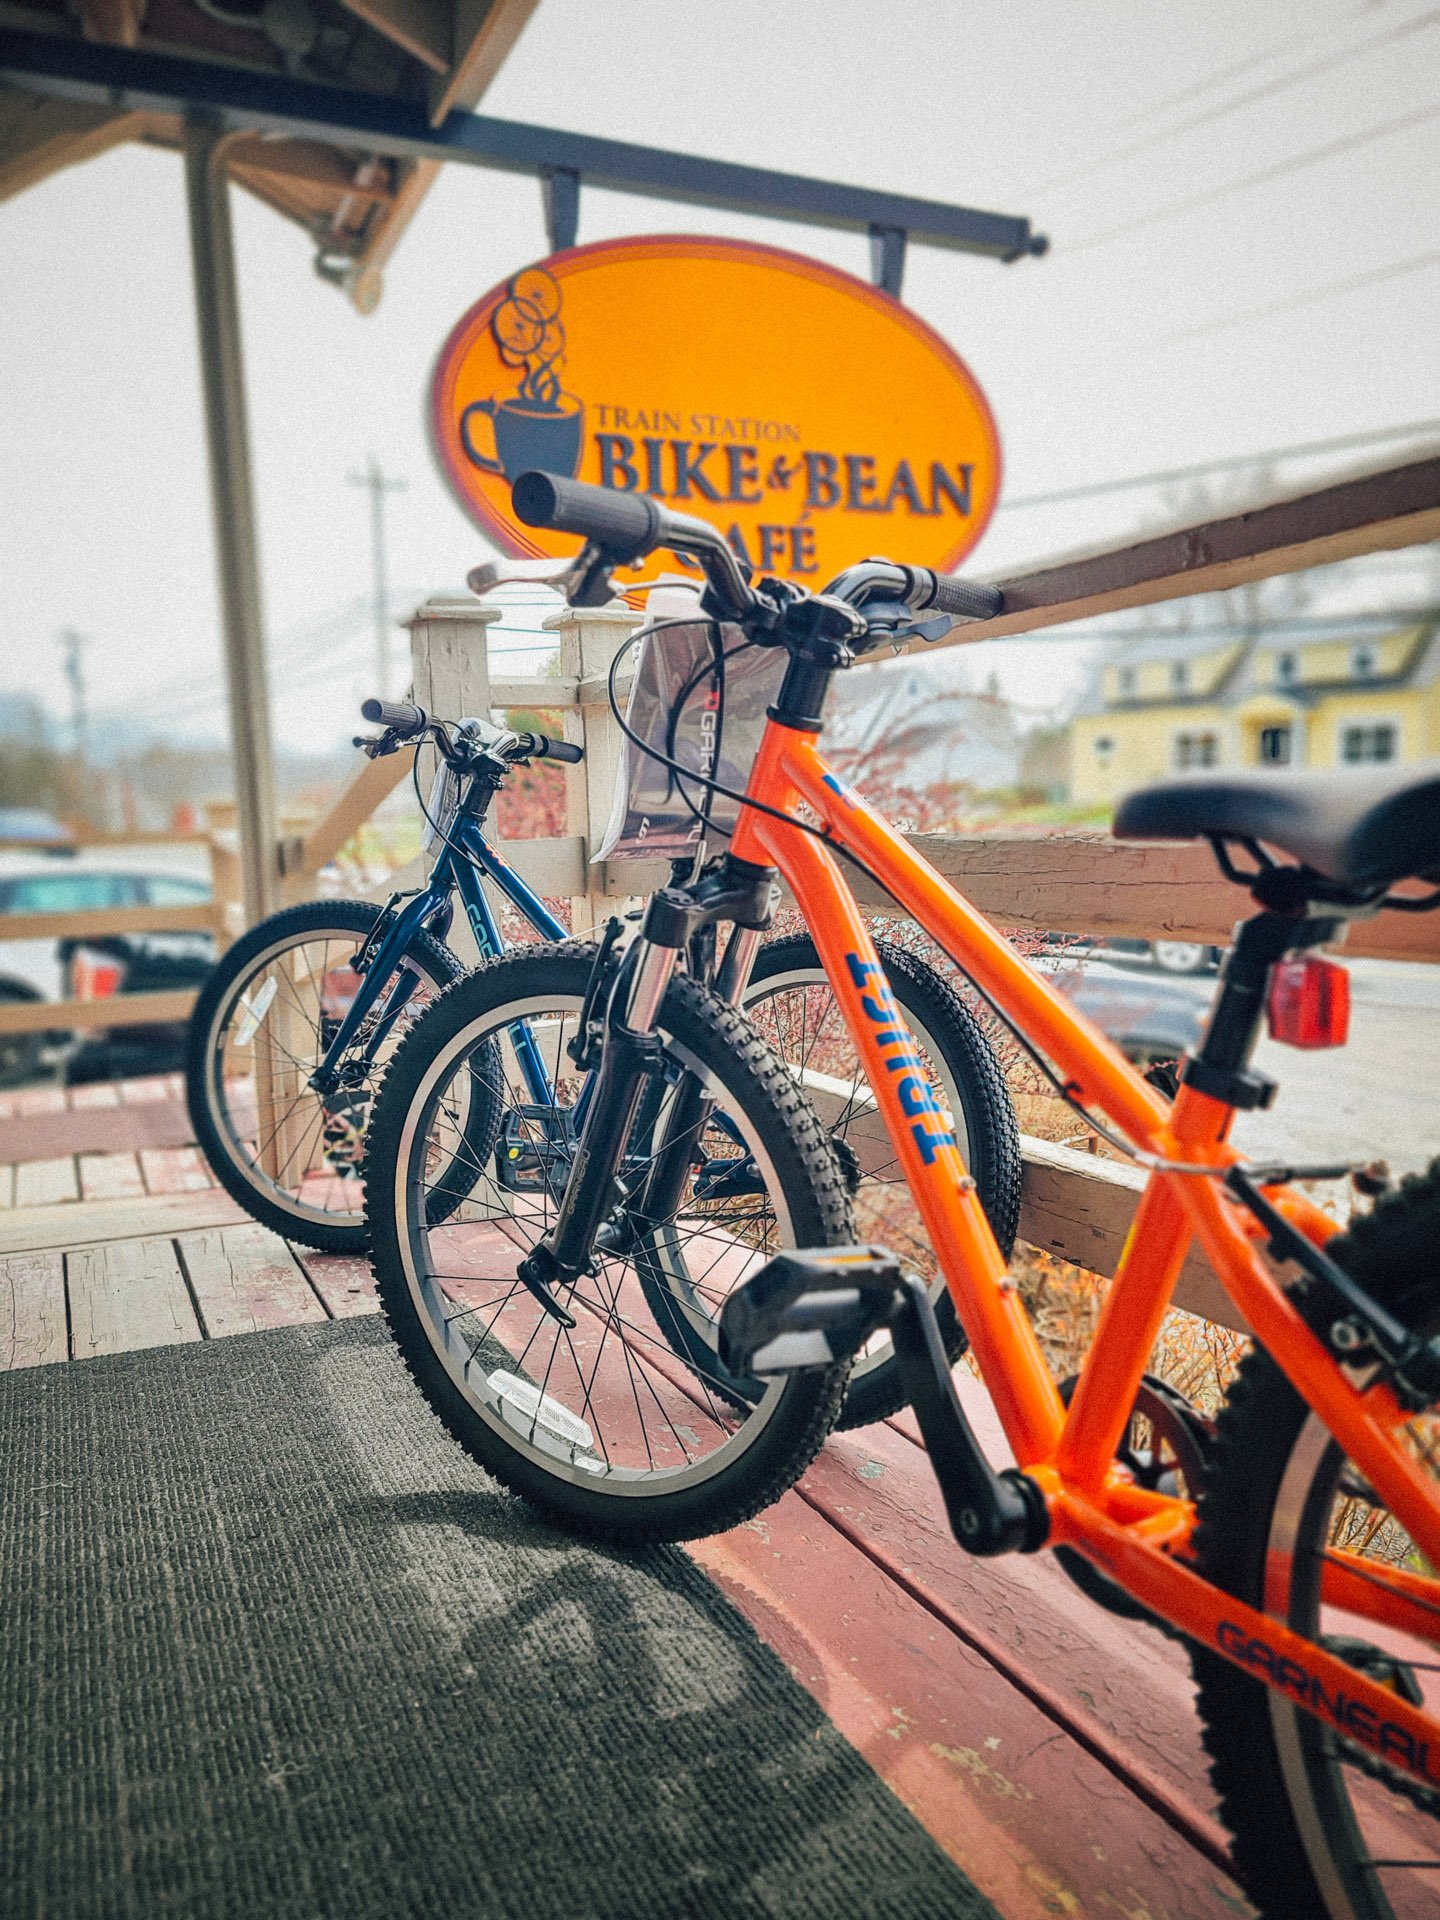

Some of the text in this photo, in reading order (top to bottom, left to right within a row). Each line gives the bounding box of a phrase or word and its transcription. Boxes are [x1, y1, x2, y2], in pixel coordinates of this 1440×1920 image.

[594, 403, 801, 443] TRAIN STATION
[594, 433, 976, 518] BIKE & BEAN
[675, 511, 820, 573] AFÉ
[567, 1148, 591, 1216] GARNEAU
